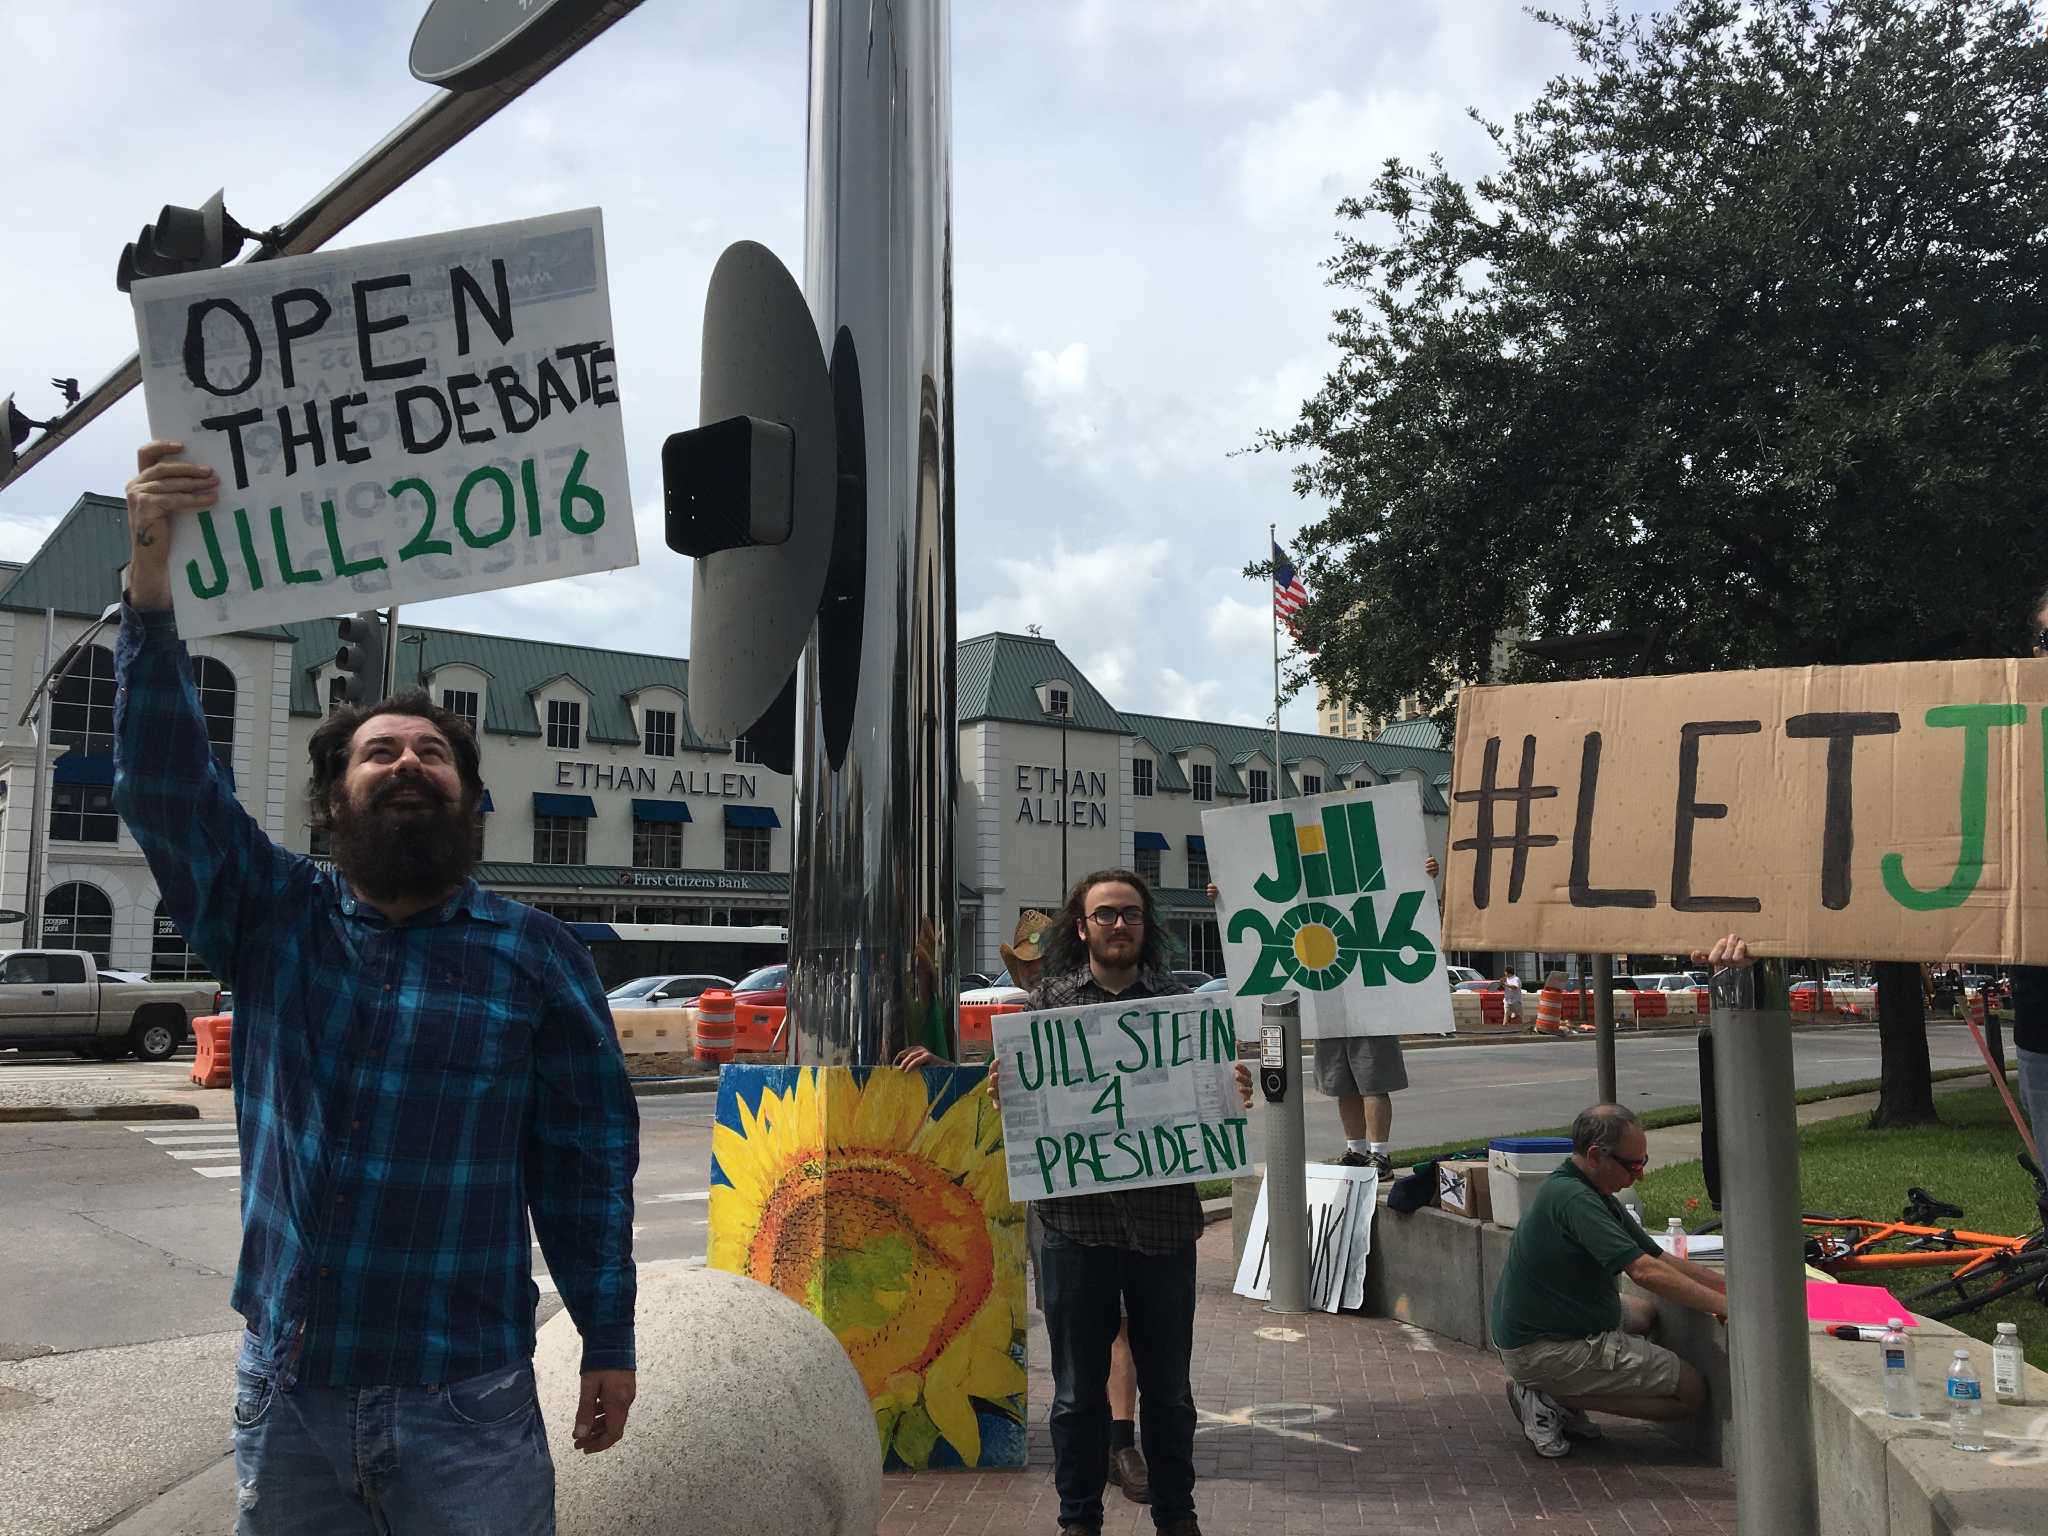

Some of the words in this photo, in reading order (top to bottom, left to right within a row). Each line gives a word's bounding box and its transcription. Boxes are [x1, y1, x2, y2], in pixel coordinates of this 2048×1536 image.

[183, 259, 514, 396] OPEN
[200, 392, 371, 489] THE
[395, 341, 619, 454] DEBATE
[556, 761, 656, 791] ETHAN
[668, 770, 756, 798] ALLEN
[1016, 764, 1106, 796] ETHAN
[1016, 796, 1106, 828] ALLEN
[633, 873, 662, 887] First
[664, 875, 715, 888] Citizens
[718, 877, 749, 889] Bank
[1253, 801, 1386, 903] Jill
[1227, 890, 1437, 997] 2016
[1016, 1015, 1110, 1091] JILL
[1114, 1008, 1236, 1073] STEIN
[1091, 1075, 1125, 1130] 4
[1035, 1118, 1248, 1194] PRESIDENT
